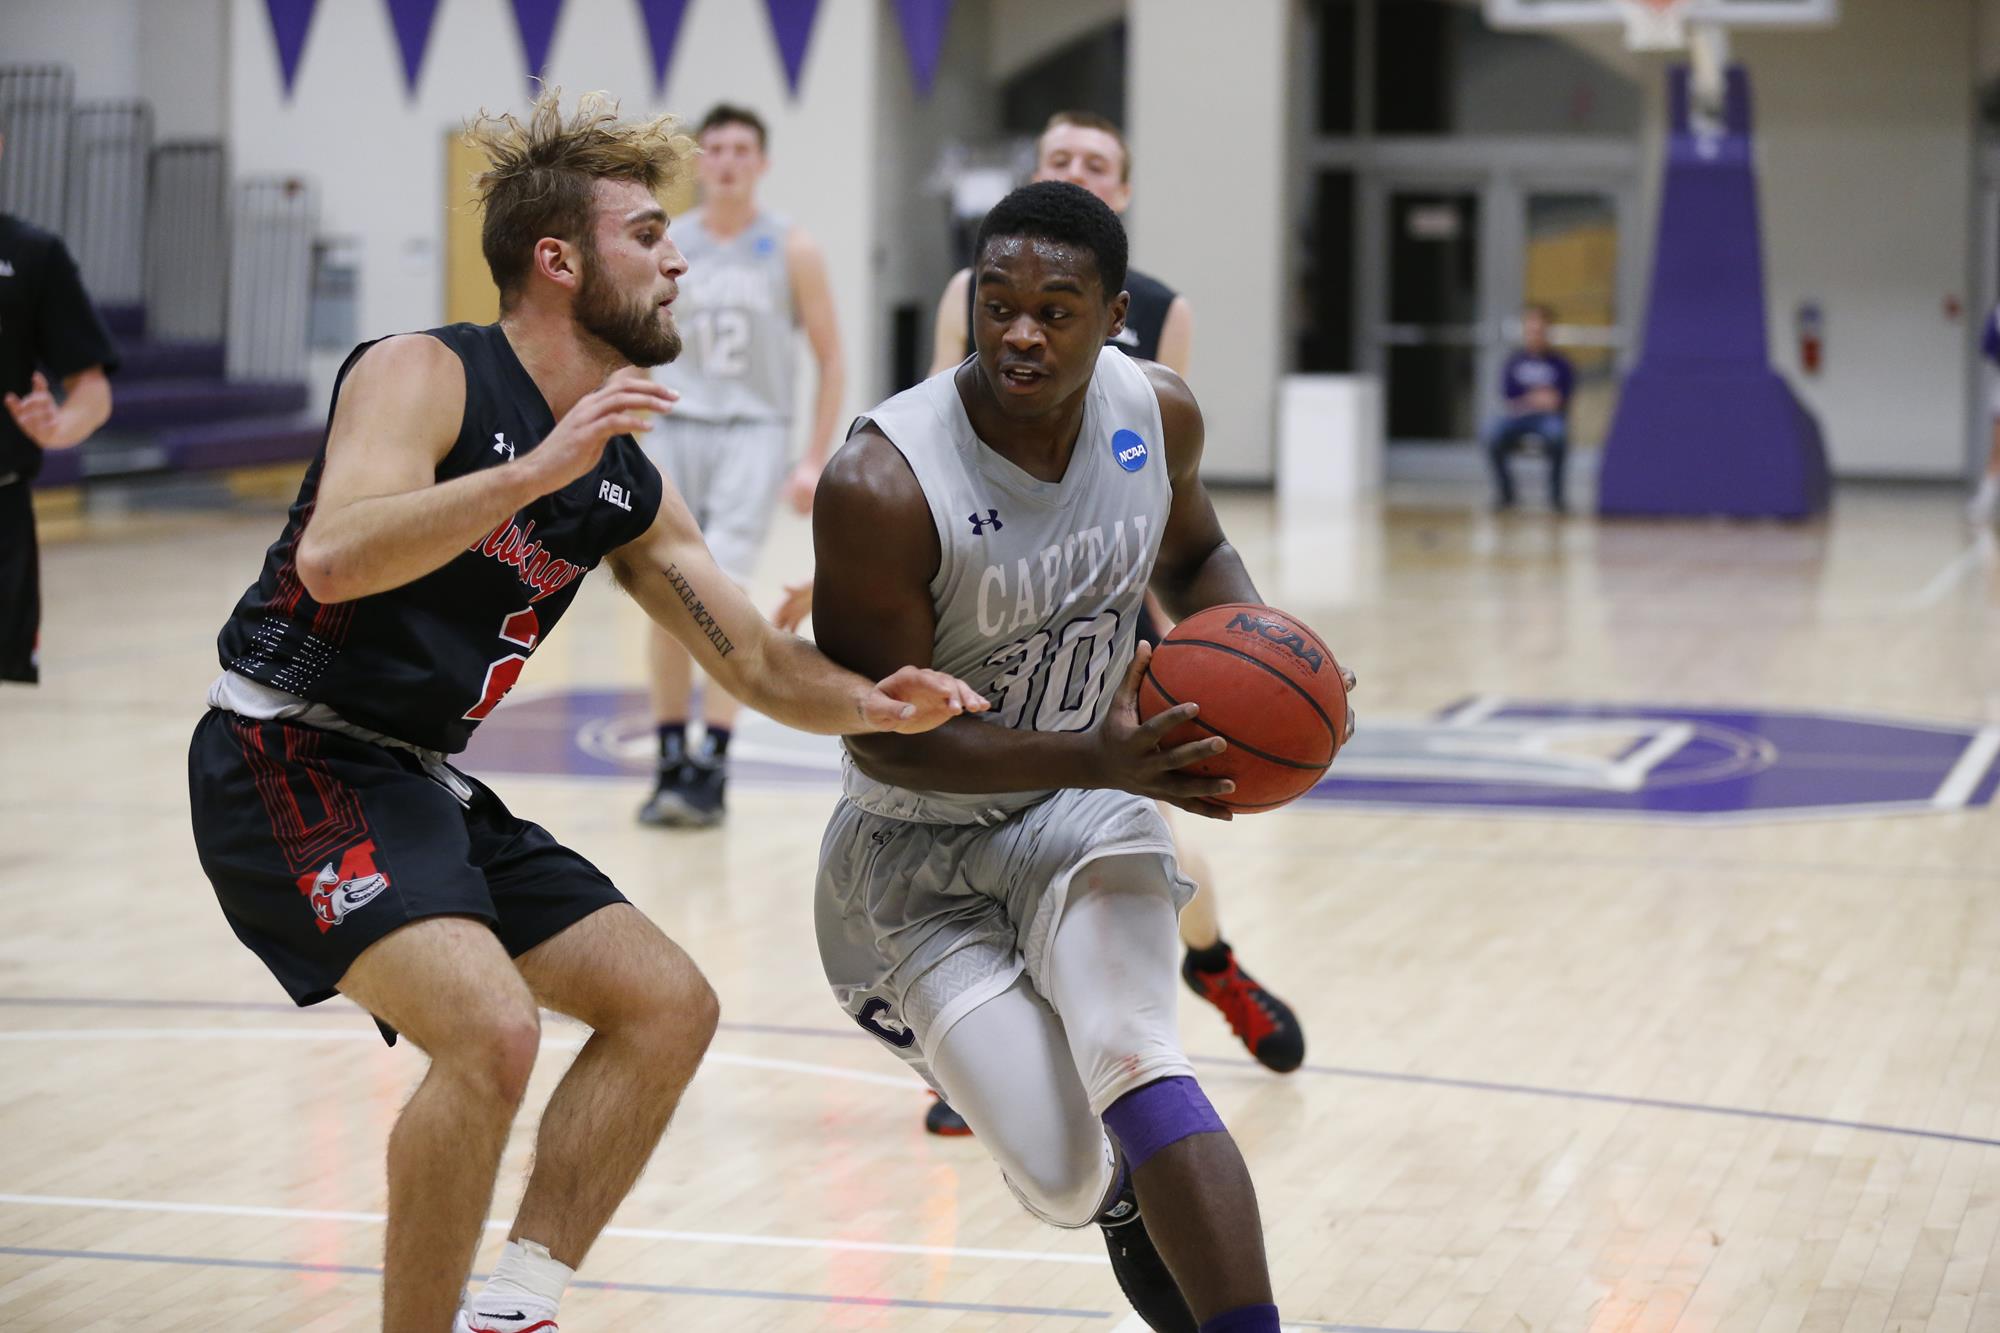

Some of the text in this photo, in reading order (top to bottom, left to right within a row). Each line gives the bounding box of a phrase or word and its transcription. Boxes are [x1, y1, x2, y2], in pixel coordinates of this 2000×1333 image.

[1119, 444, 1147, 463] NCAA
[598, 479, 633, 512] RELL
[977, 515, 1152, 637] CAPITAL
[983, 608, 1121, 733] 30
[1225, 612, 1323, 674] NCAA
